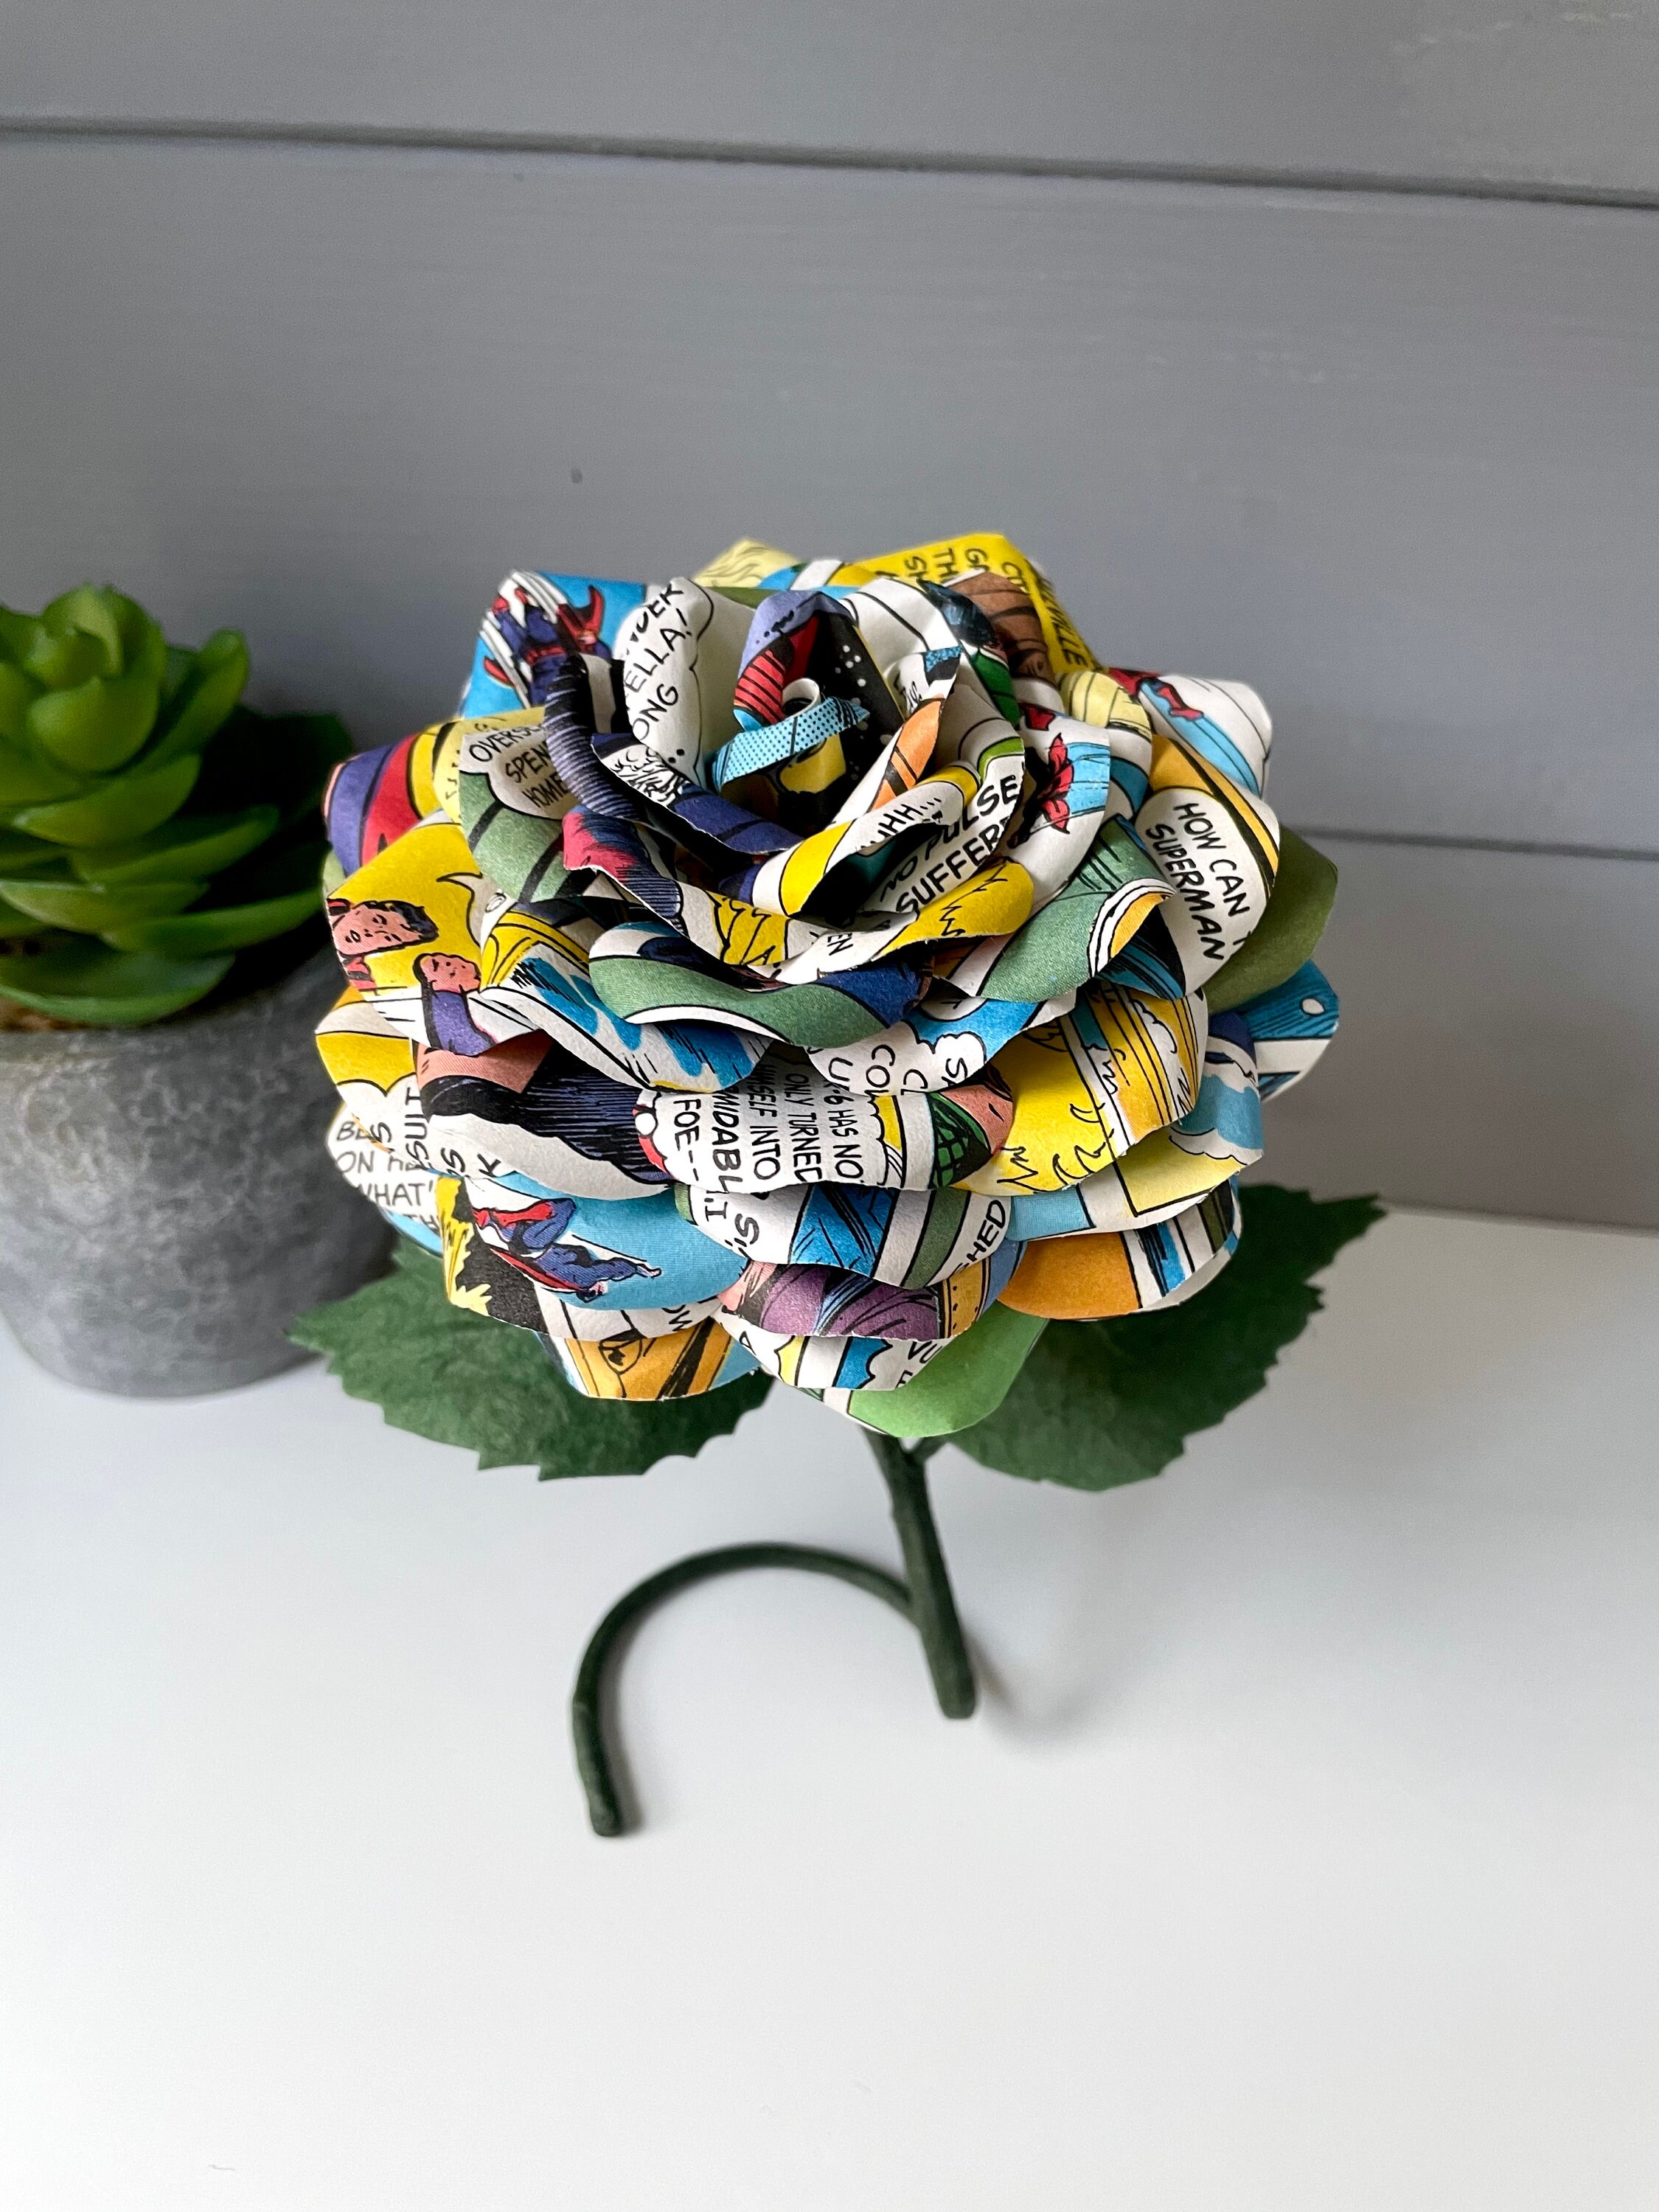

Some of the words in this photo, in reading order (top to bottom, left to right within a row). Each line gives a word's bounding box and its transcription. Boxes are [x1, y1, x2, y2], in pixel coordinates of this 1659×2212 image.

[625, 608, 692, 694] ELLA!
[1173, 803, 1227, 849] HOW
[1208, 859, 1251, 917] CAN
[1145, 824, 1225, 961] SUPERMAN
[745, 1062, 778, 1118] HIMSELF
[784, 1073, 815, 1107] ONLY
[827, 1109, 860, 1137] HAS
[749, 1125, 781, 1180] INTO
